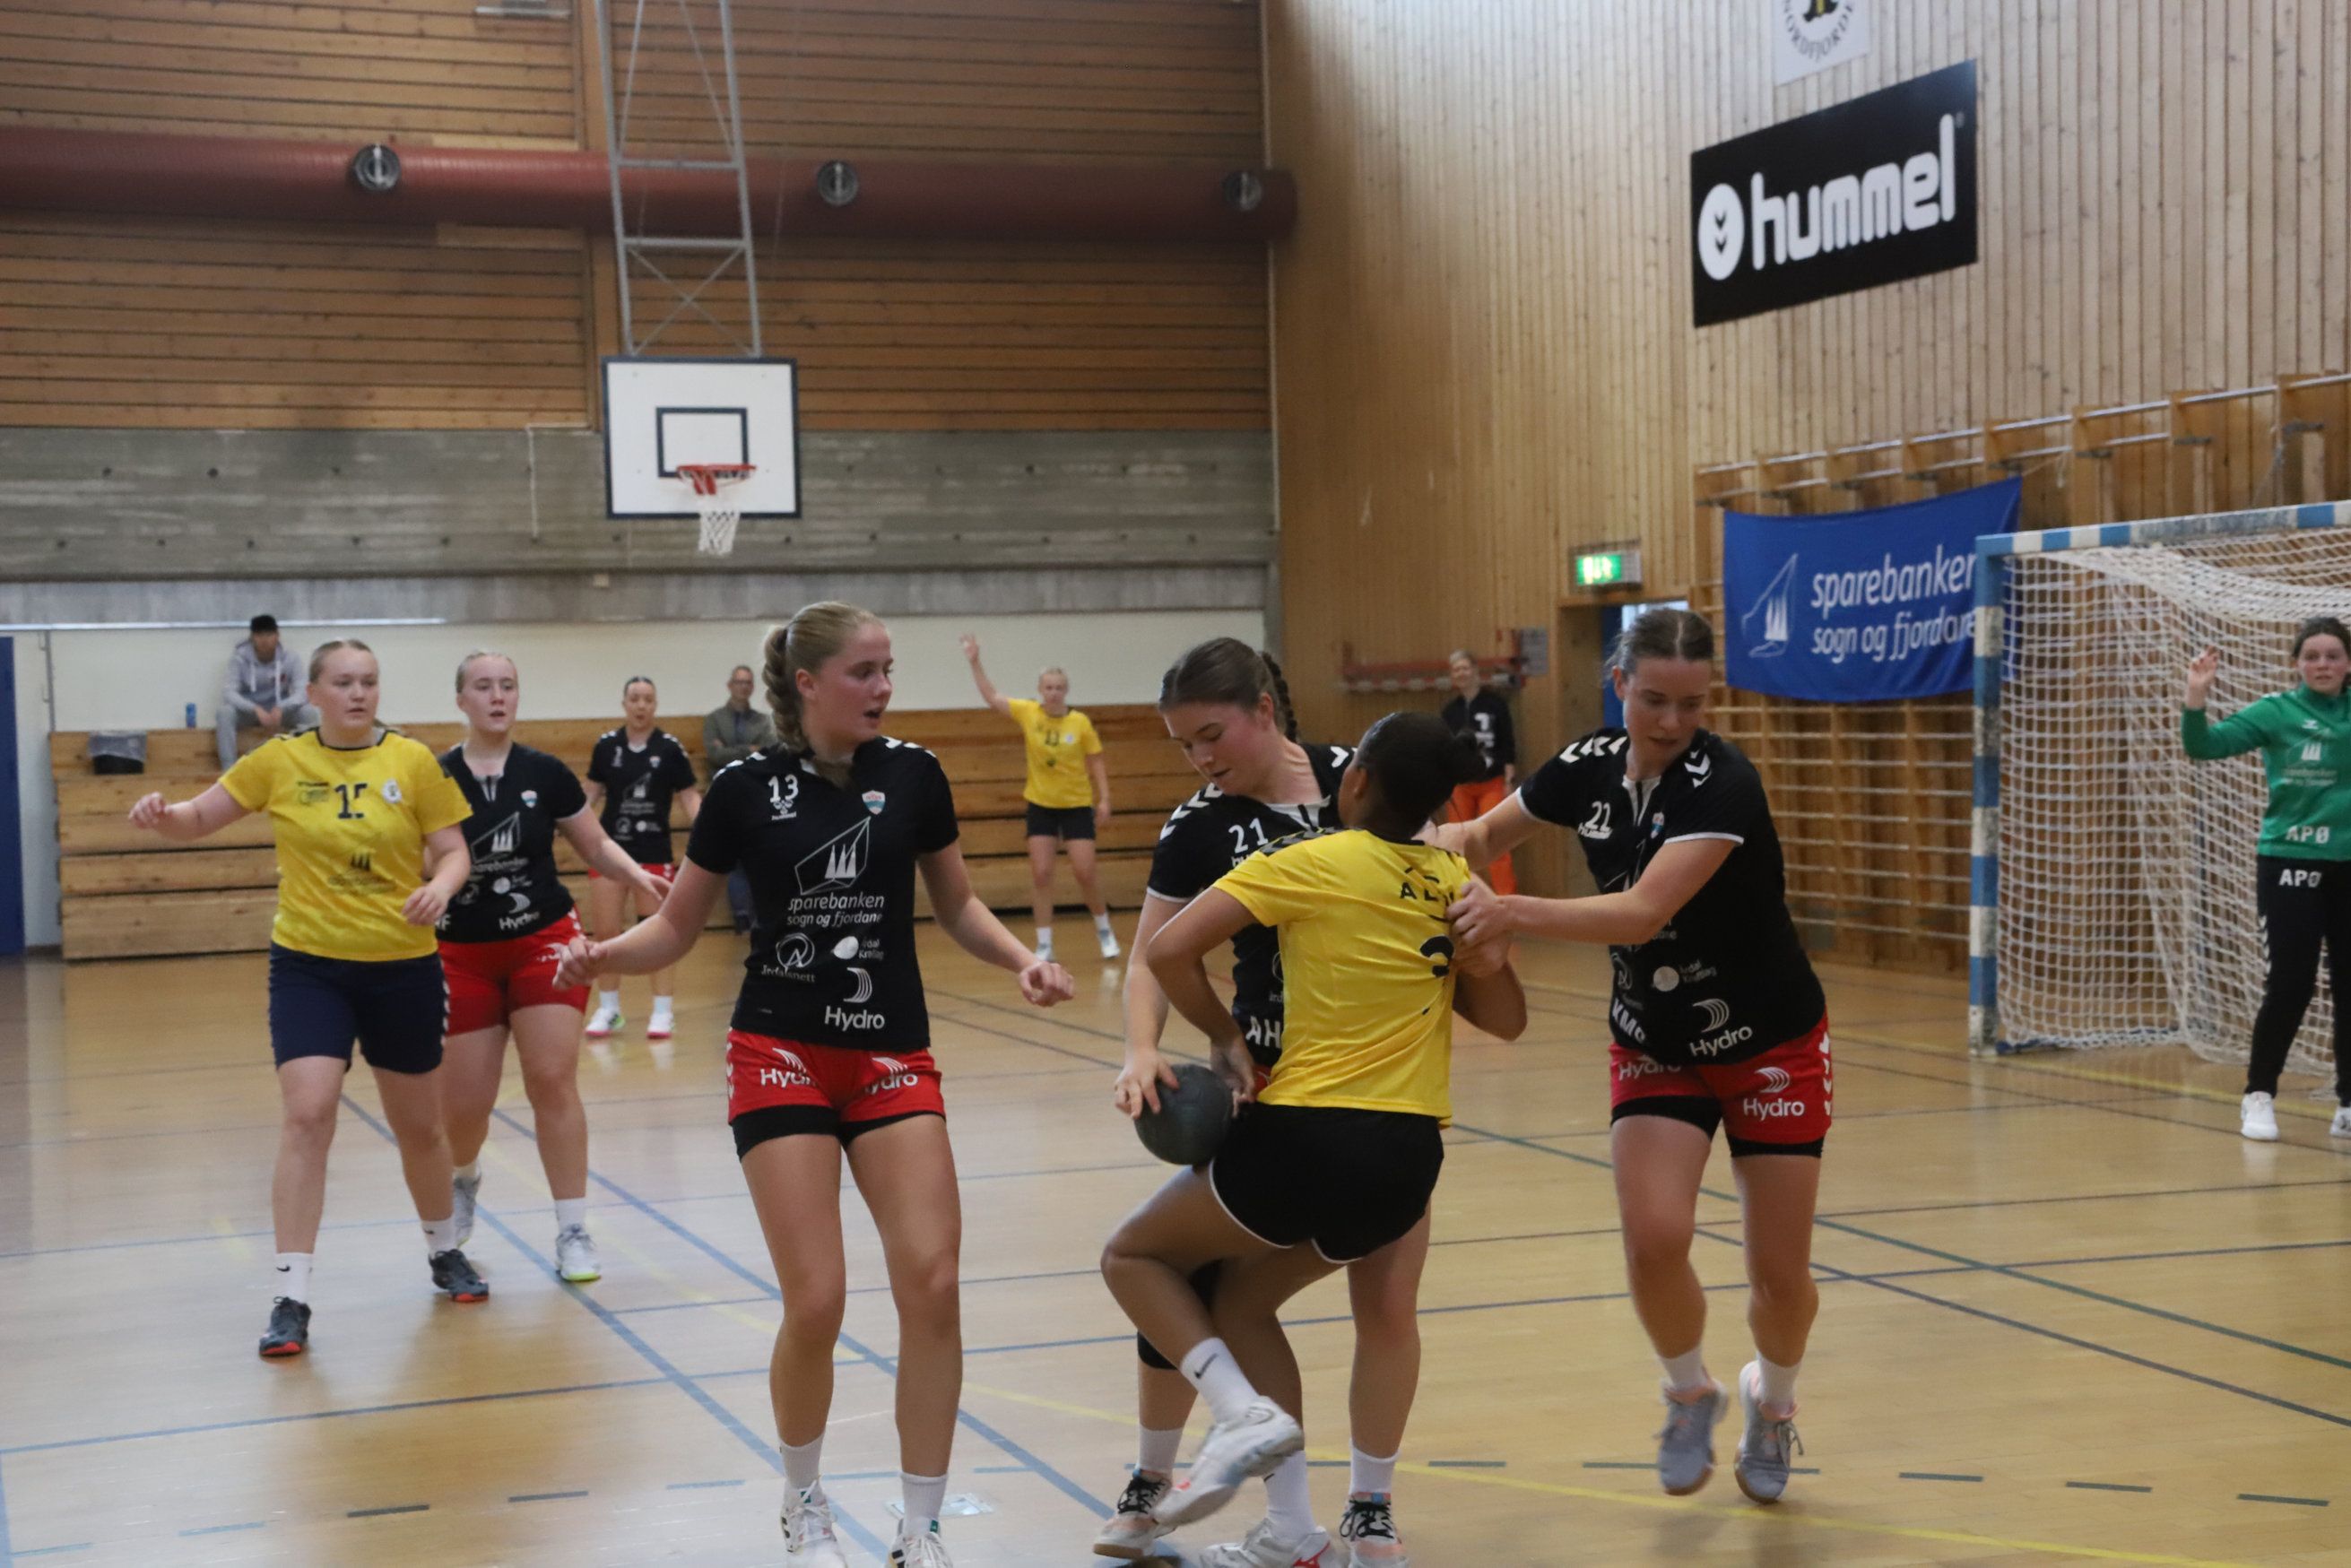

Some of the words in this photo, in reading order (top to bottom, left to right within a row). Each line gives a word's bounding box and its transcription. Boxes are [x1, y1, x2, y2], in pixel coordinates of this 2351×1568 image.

[1751, 114, 1955, 271] hummel
[1811, 627, 1858, 663] sogn
[1861, 626, 1887, 663] og
[768, 775, 799, 802] 13
[1228, 818, 1268, 853] 21
[788, 891, 884, 914] sparebanken
[787, 914, 814, 928] sogn
[816, 914, 831, 928] og
[825, 1006, 885, 1032] Hydro
[1689, 1027, 1753, 1056] Hydro
[1743, 1098, 1805, 1121] Hydro
